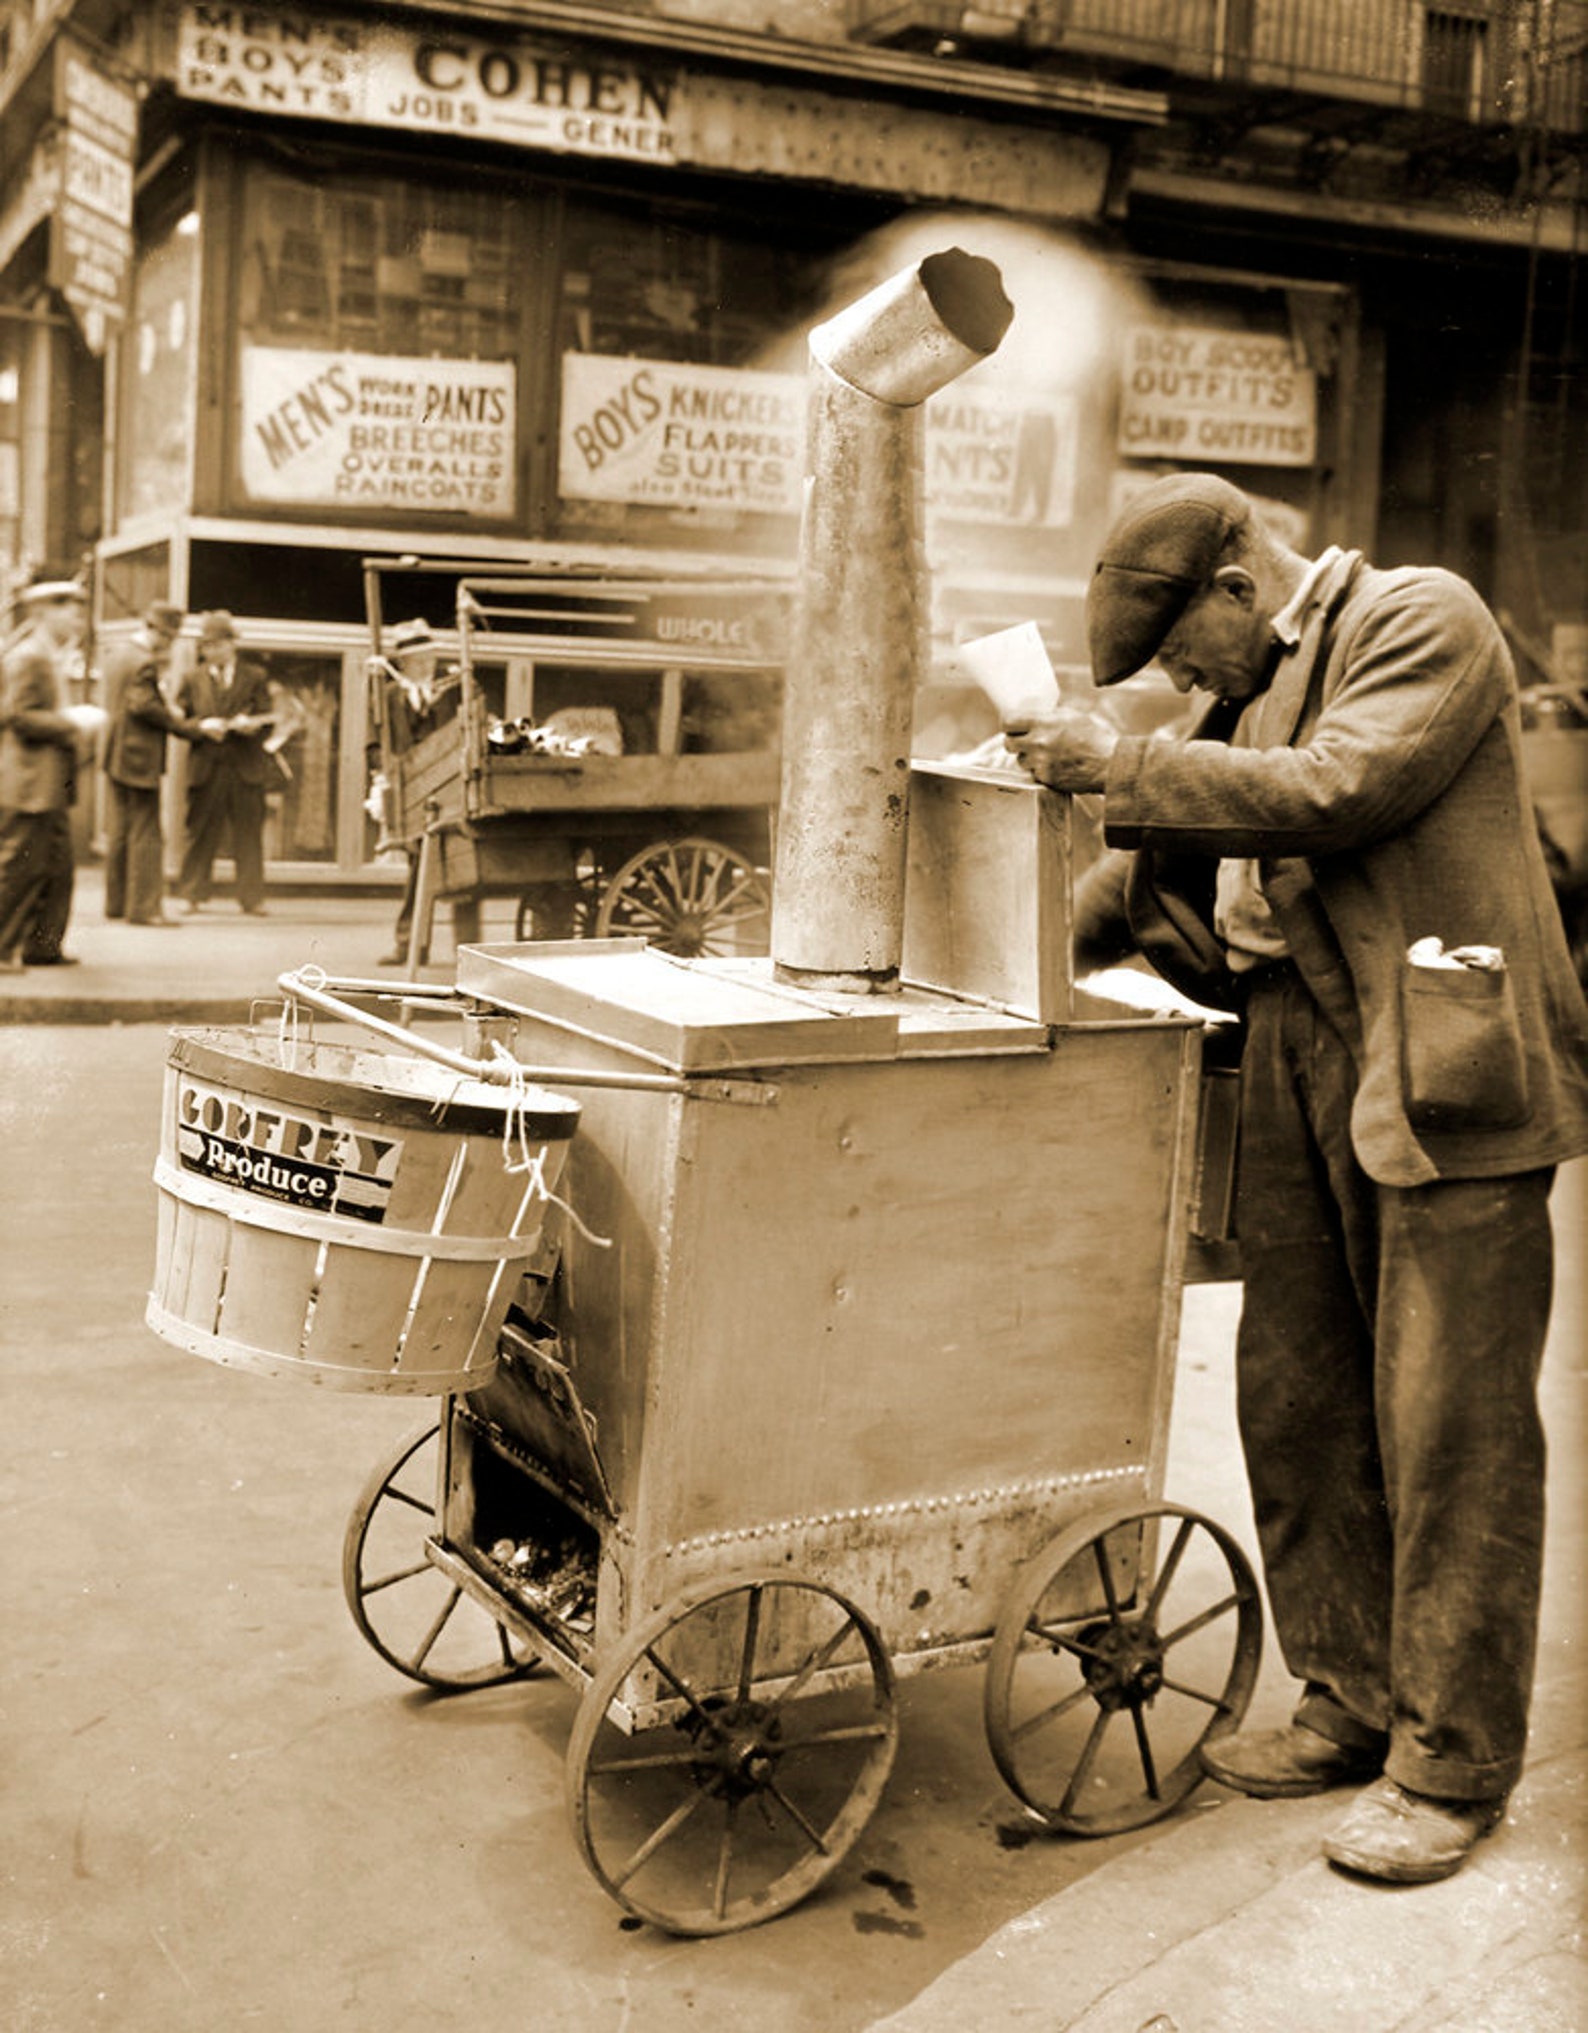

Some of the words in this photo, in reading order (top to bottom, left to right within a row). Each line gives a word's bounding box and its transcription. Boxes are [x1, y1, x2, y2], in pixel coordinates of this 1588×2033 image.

[188, 68, 352, 113] PANTS
[413, 44, 674, 124] COHEN
[389, 94, 478, 126] JOBS
[1134, 332, 1196, 364] BOY
[359, 377, 416, 397] WORK
[422, 383, 507, 424] PANTS
[1132, 367, 1295, 409] OUTFITS
[255, 365, 355, 470] MEN'S
[574, 369, 661, 472] BOYS
[1124, 414, 1189, 444] CAMP
[1198, 418, 1305, 452] OUTFITS
[349, 424, 503, 458] BREECHES
[664, 423, 797, 458] FLAPPERS
[342, 452, 504, 479] OVERALLS
[655, 453, 786, 485] SUITS
[934, 443, 1013, 484] NTS
[335, 475, 498, 505] RAINCOATS
[656, 617, 744, 645] WHOLE
[182, 1089, 396, 1176] GODFREY
[206, 1138, 328, 1198] Produce
